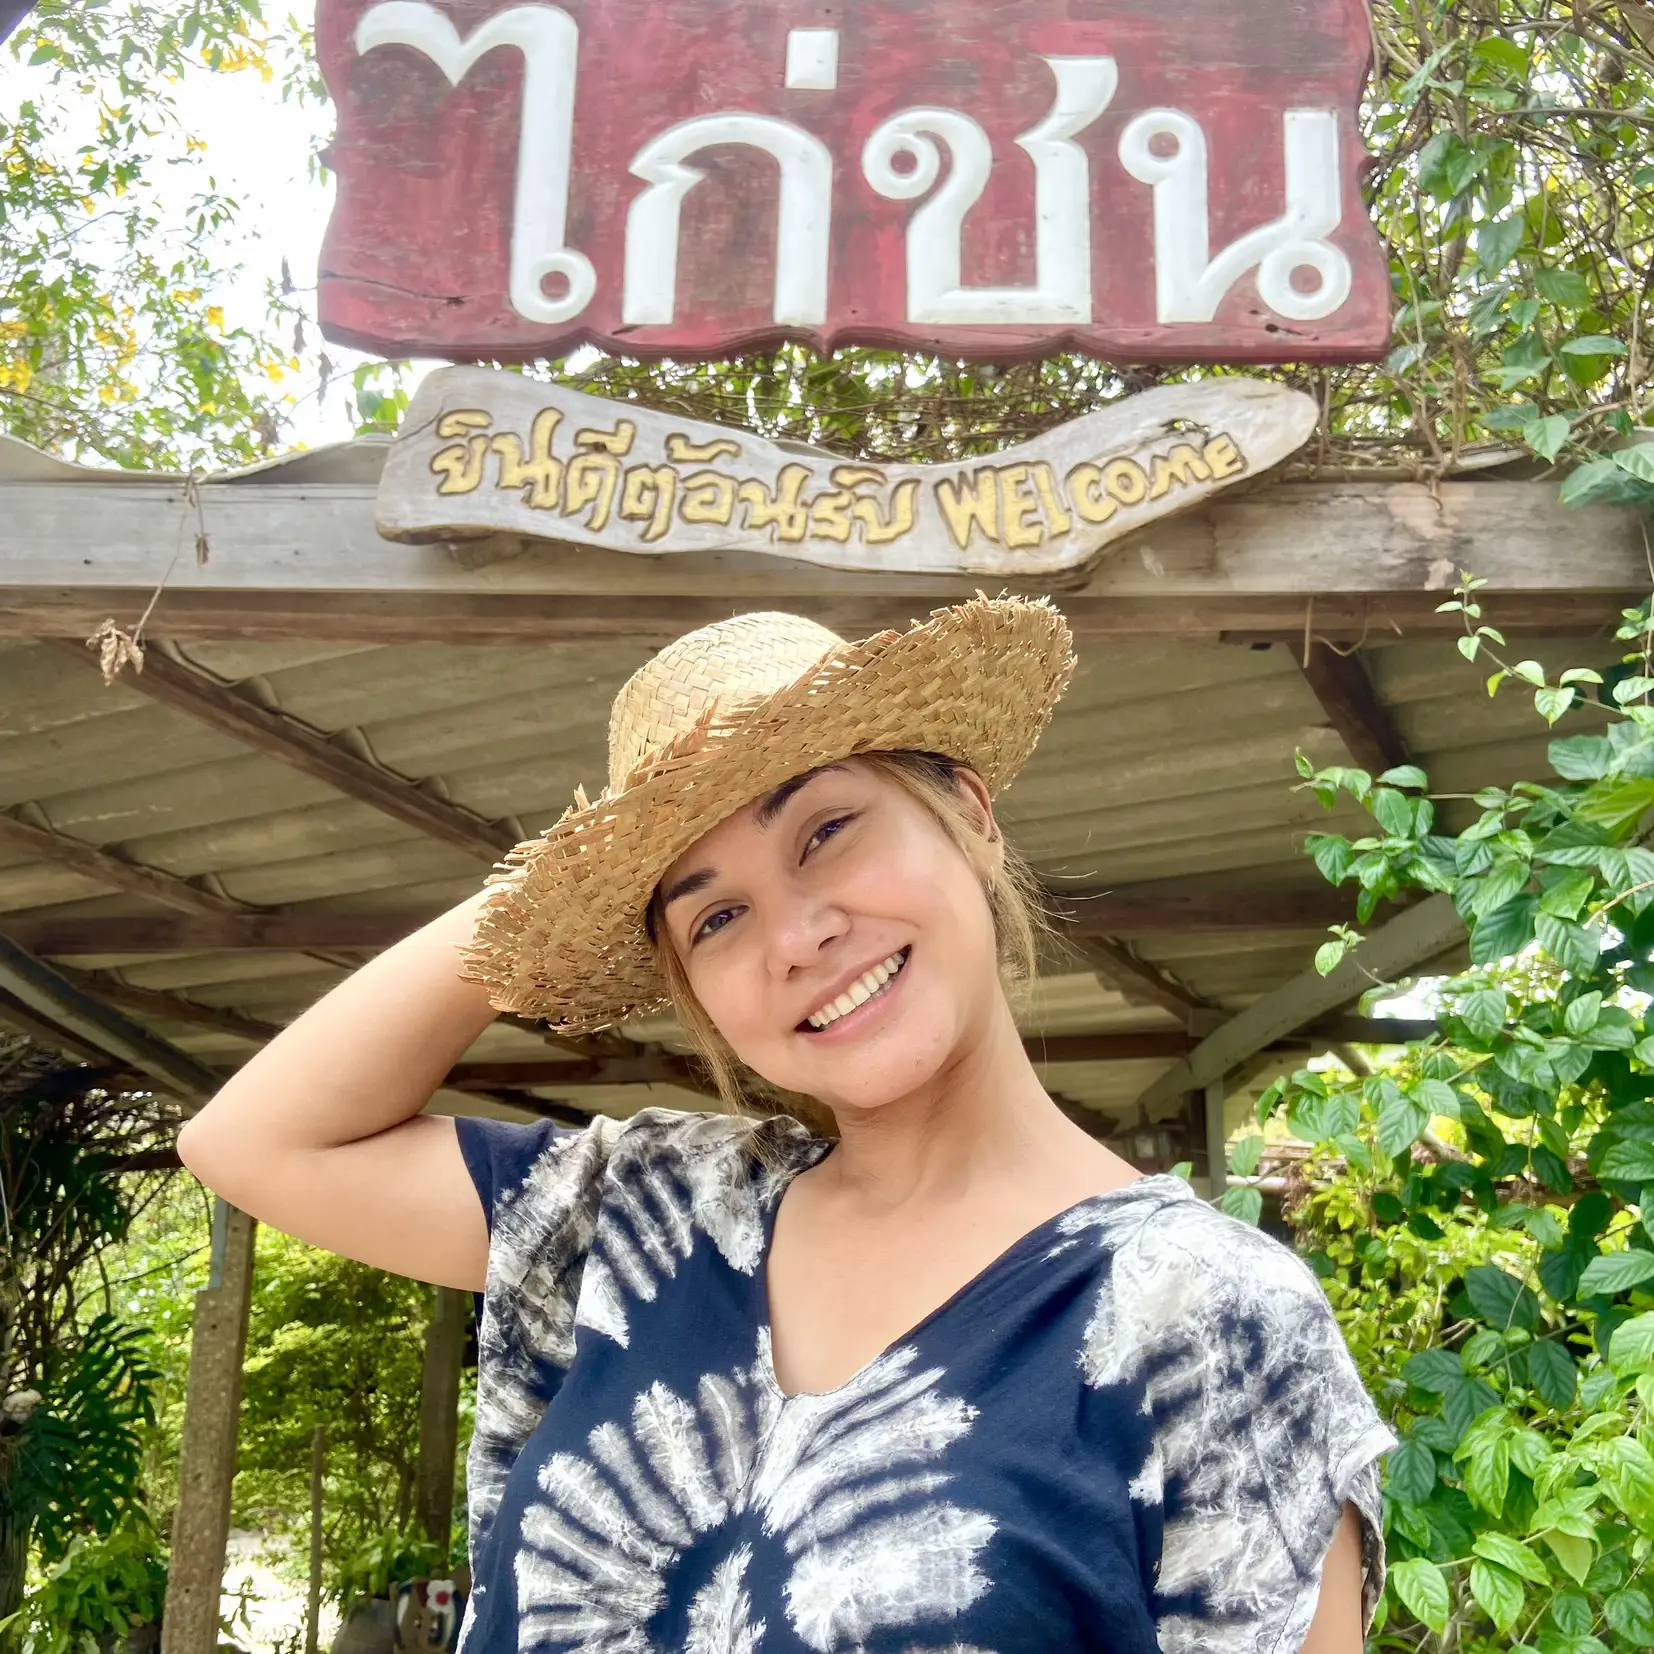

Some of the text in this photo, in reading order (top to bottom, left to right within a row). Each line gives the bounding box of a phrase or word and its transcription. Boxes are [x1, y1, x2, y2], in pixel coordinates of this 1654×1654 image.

[355, 2, 1352, 325] ไก่ชน
[430, 406, 1248, 549] ยินดีต้อนรับ WELCOME
